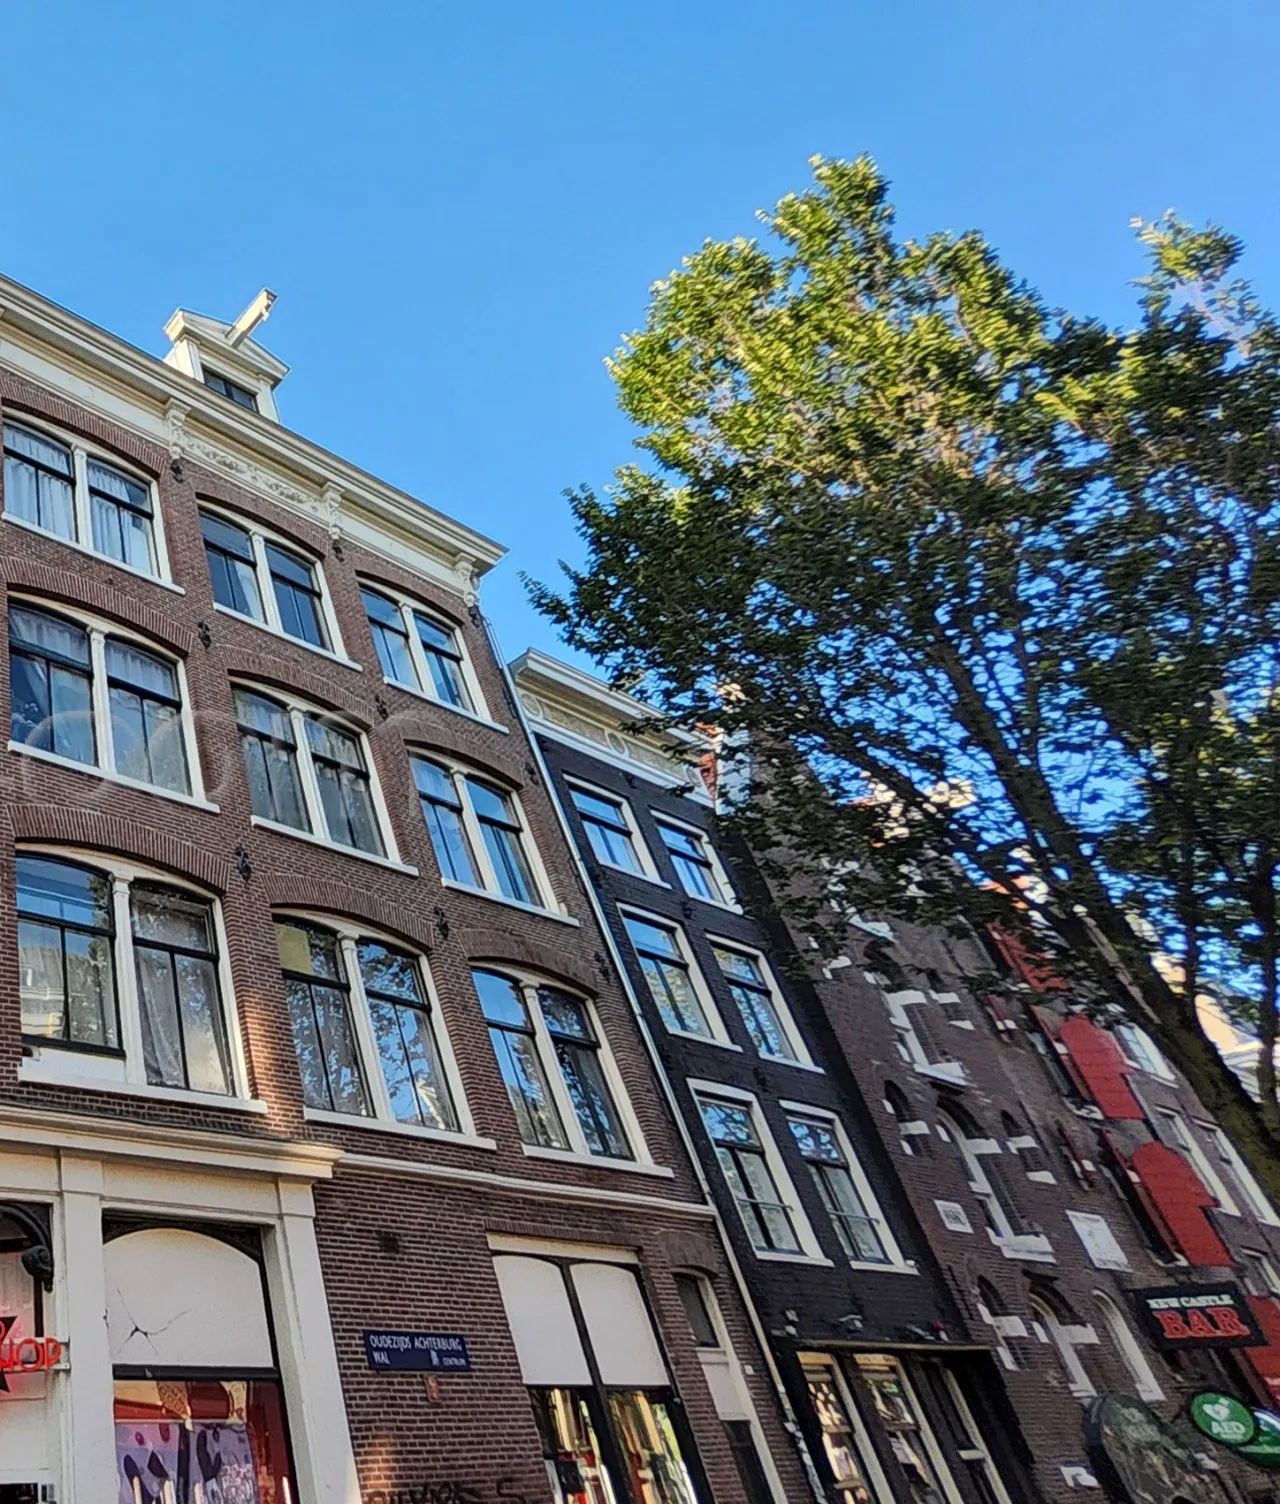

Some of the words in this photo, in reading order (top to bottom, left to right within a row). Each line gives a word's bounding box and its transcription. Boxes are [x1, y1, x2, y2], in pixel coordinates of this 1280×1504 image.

[1153, 1307, 1251, 1339] BAR
[369, 1335, 412, 1352] OUDEZIJDS
[1210, 1420, 1246, 1435] AED
